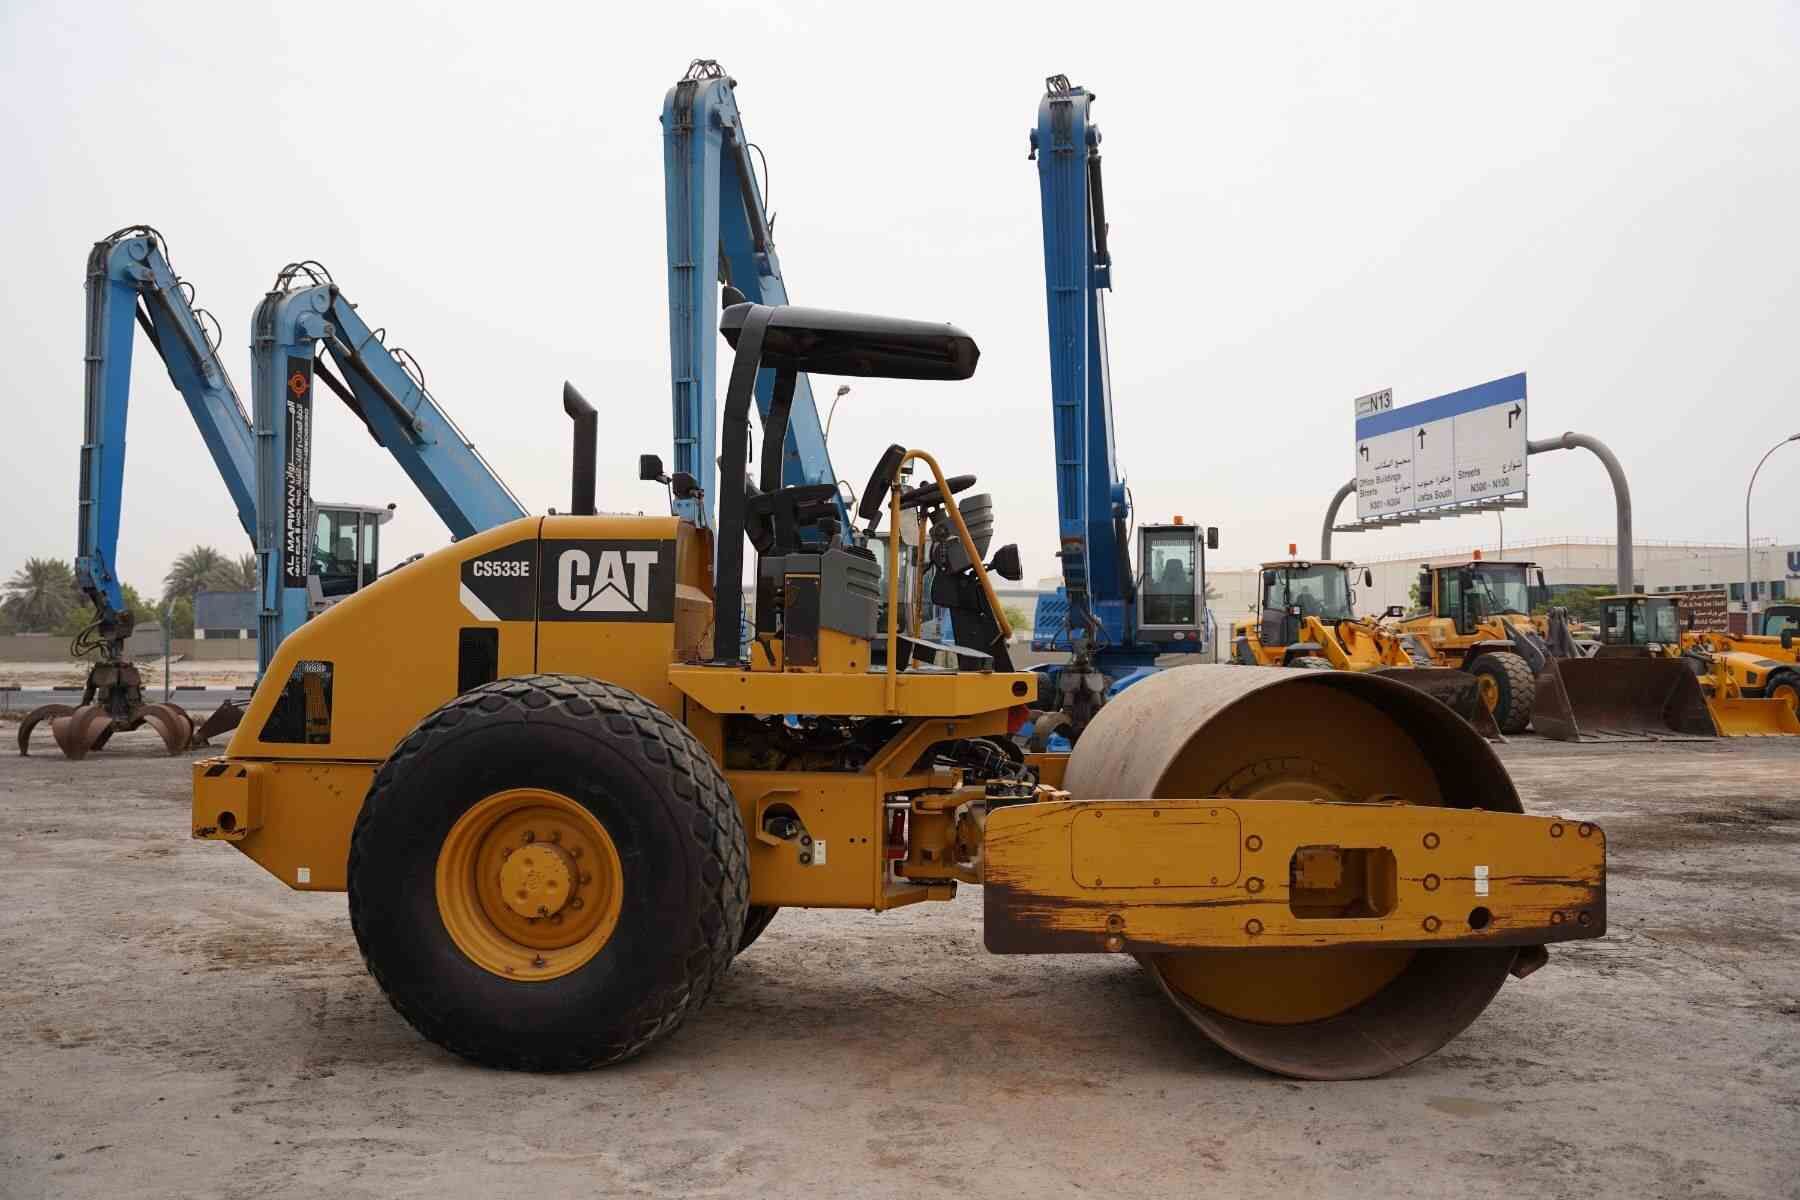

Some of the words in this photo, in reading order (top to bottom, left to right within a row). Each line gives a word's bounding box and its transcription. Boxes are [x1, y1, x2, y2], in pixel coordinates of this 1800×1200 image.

[1370, 391, 1391, 412] N13
[1457, 467, 1480, 480] Streets
[1434, 488, 1453, 500] South
[287, 484, 295, 552] MARWAN
[287, 555, 294, 577] AL
[473, 561, 529, 576] CS533E
[557, 549, 658, 612] CAT
